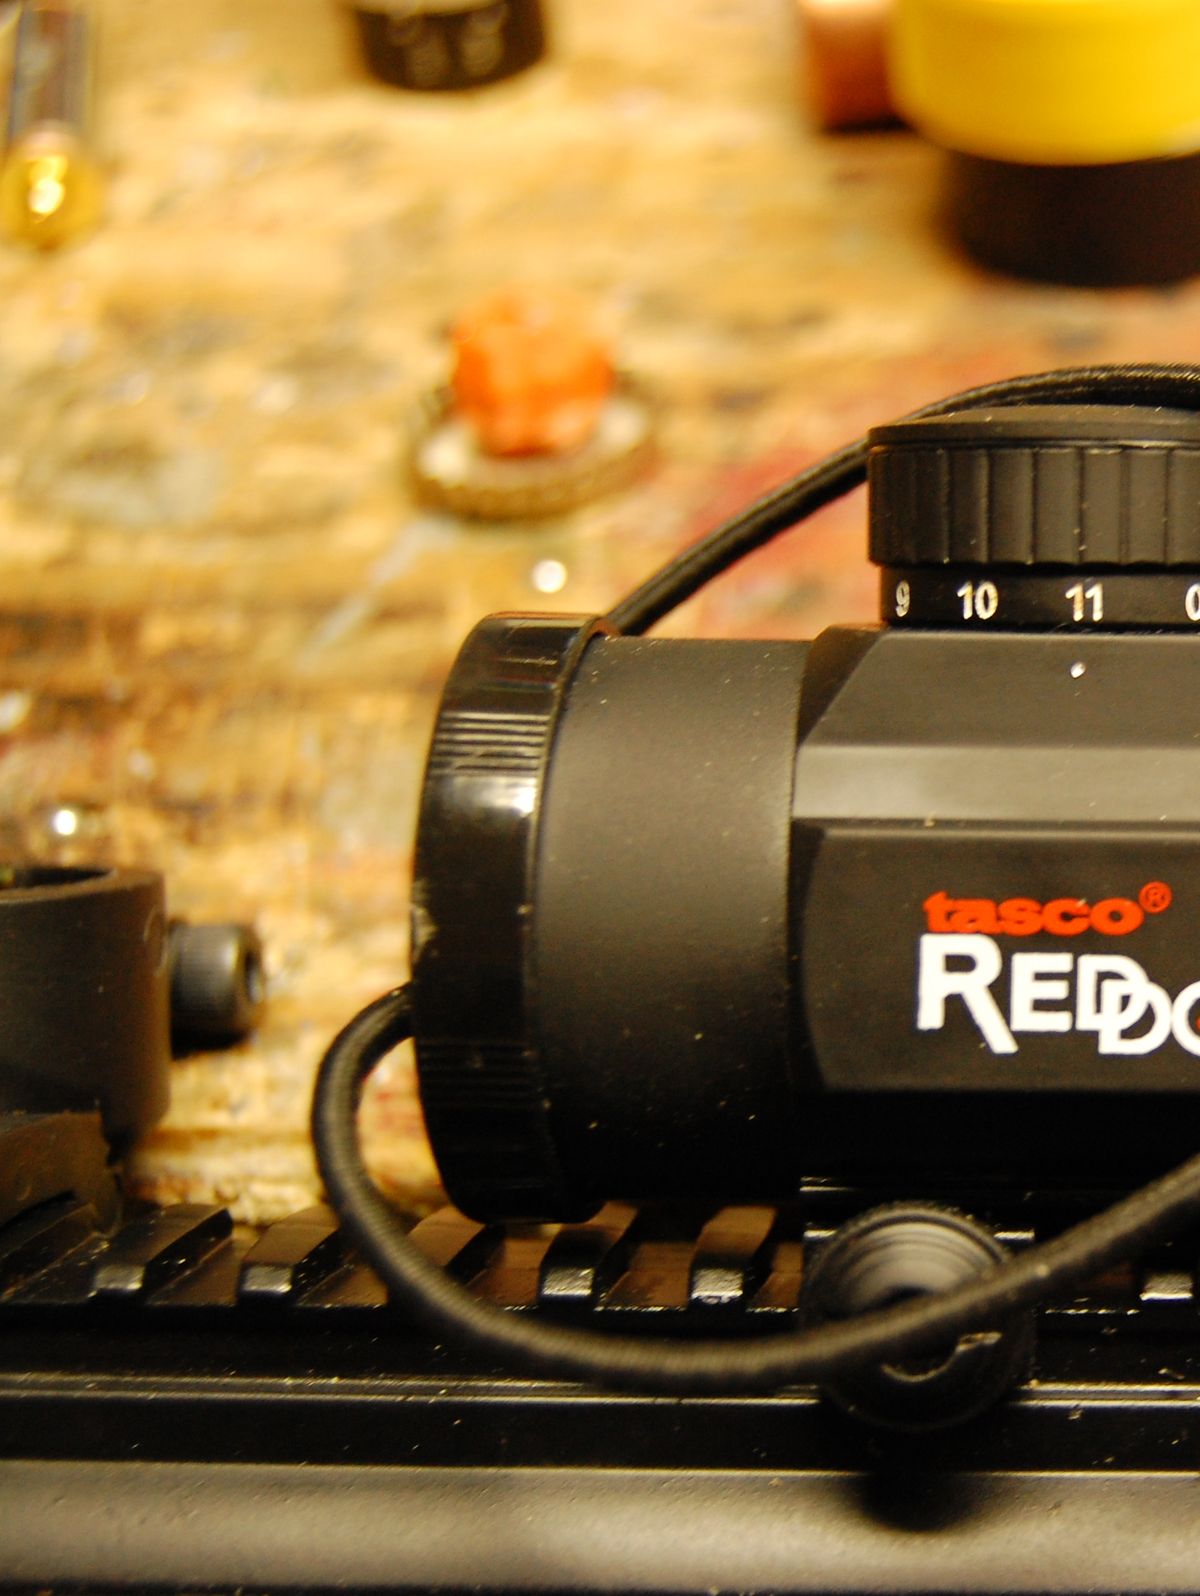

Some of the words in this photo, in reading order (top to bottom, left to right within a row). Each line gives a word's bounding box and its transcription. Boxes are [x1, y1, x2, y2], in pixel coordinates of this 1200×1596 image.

[895, 580, 910, 618] 9
[957, 581, 999, 621] 10
[1065, 583, 1105, 622] 11
